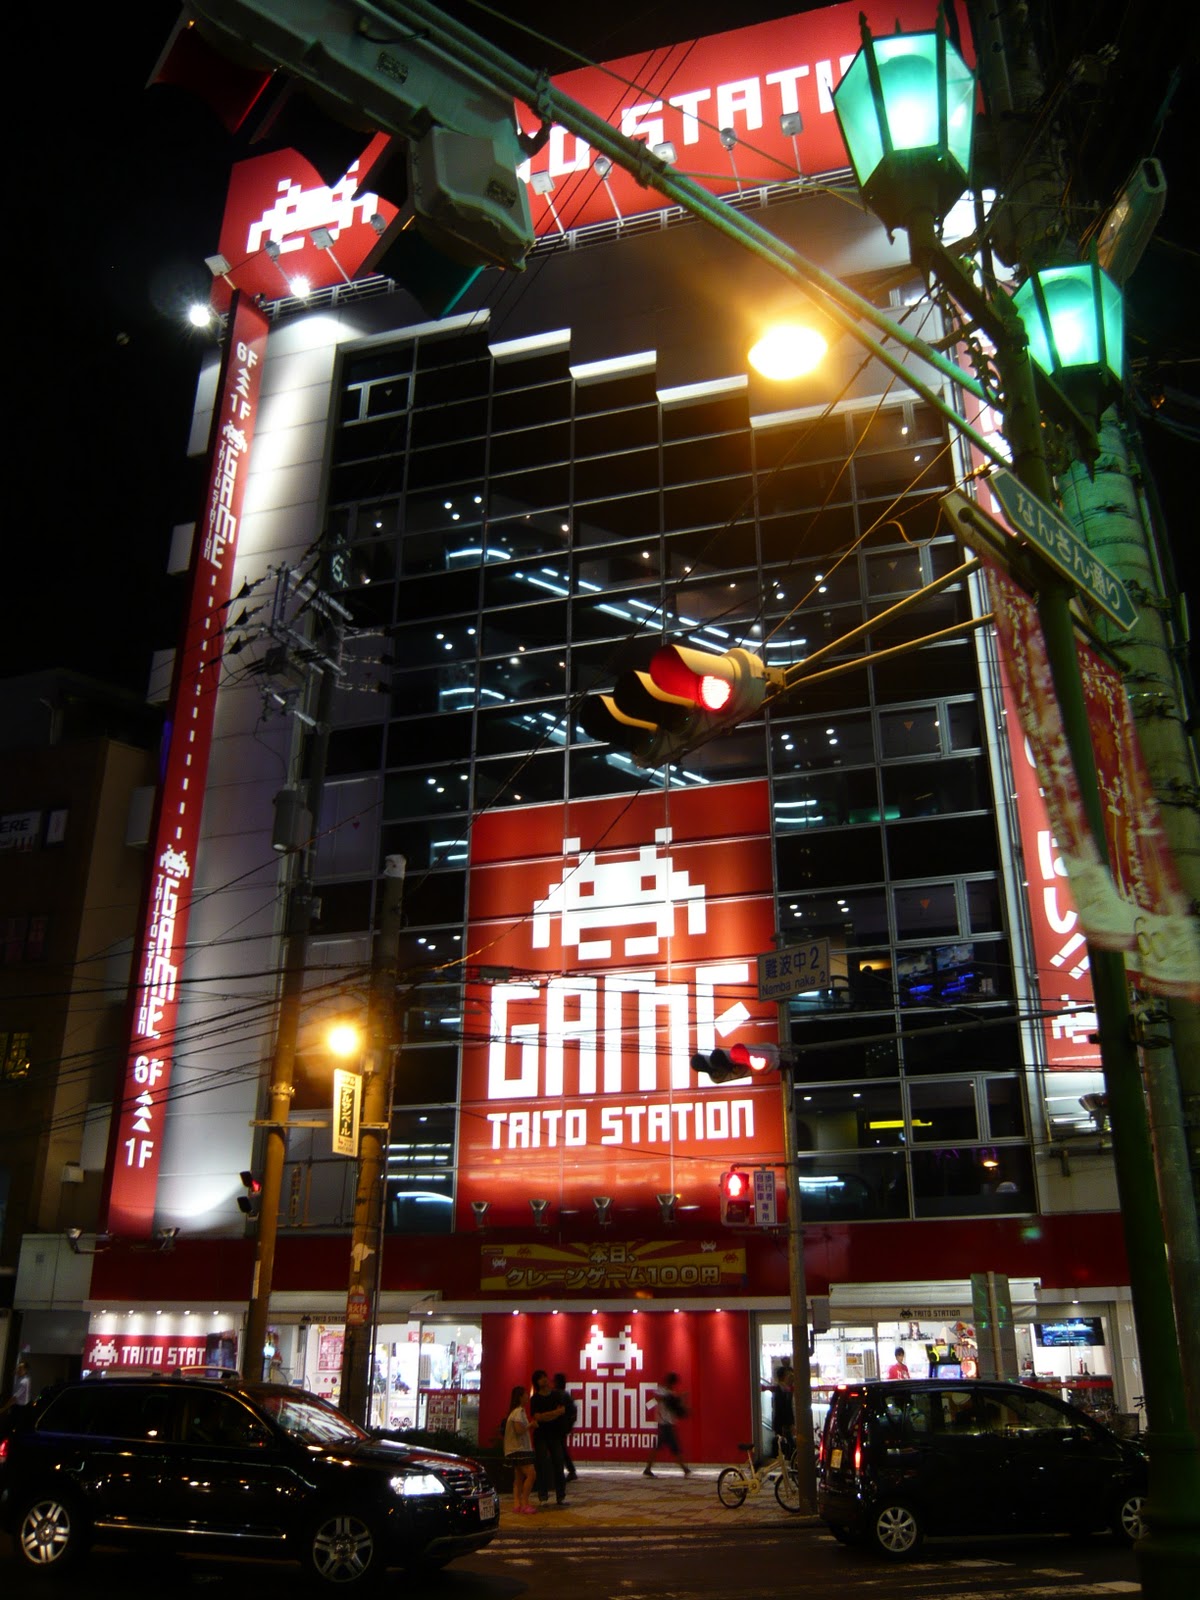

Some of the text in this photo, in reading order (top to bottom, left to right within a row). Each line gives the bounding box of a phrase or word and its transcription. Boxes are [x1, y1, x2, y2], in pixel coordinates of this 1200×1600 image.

[621, 54, 858, 158] STATI
[237, 341, 258, 368] 6F
[230, 393, 251, 420] 1F
[1015, 492, 1122, 611] なんさん通り
[146, 877, 180, 1039] GAME
[765, 945, 819, 979] 難波中2
[762, 980, 791, 996] Namba
[794, 973, 816, 988] naka
[488, 963, 753, 1100] GAME
[134, 1055, 164, 1087] 6F
[487, 1099, 754, 1150] TAITO STATION
[125, 1137, 154, 1168] 1F
[589, 1245, 636, 1264] 本日、
[506, 1265, 723, 1289] クレーンゲーム100円
[913, 1309, 961, 1318] TAITO STATION
[122, 1346, 207, 1366] TAITO STAT
[565, 1381, 659, 1429] GAME
[605, 1432, 659, 1449] STATION
